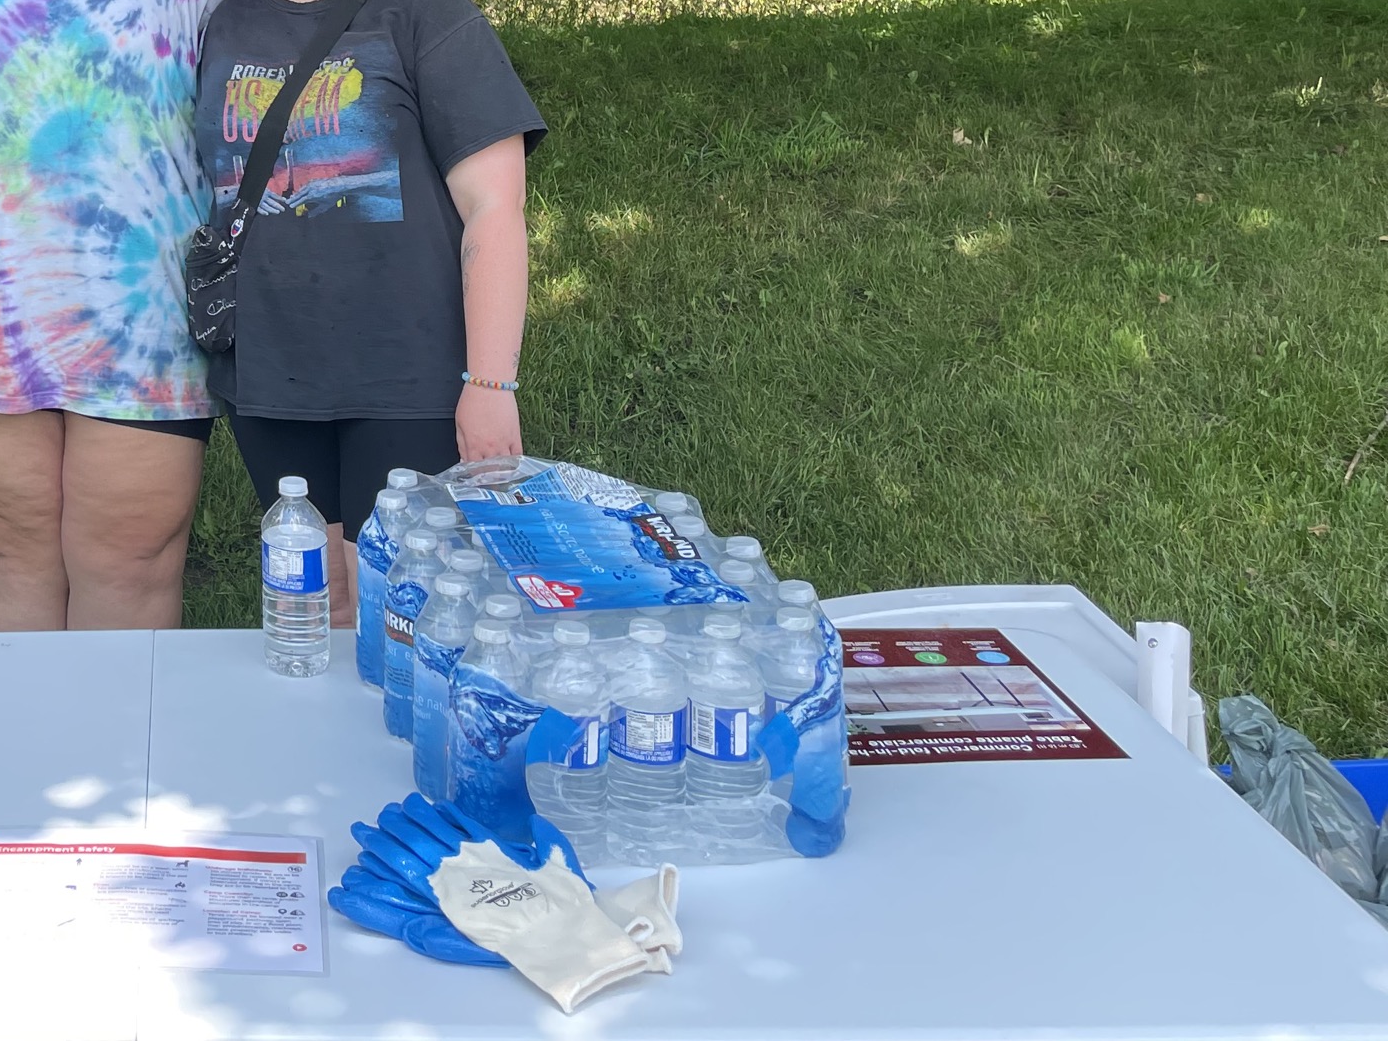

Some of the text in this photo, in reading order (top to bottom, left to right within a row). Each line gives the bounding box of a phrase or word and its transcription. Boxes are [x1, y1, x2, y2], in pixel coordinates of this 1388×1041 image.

[222, 78, 262, 143] US
[868, 737, 973, 748] commerciale
[976, 734, 1033, 746] pliante
[1035, 734, 1083, 744] Table
[848, 746, 929, 757] fold-in-ha
[934, 744, 1033, 755] Commercial
[78, 845, 116, 855] Safety
